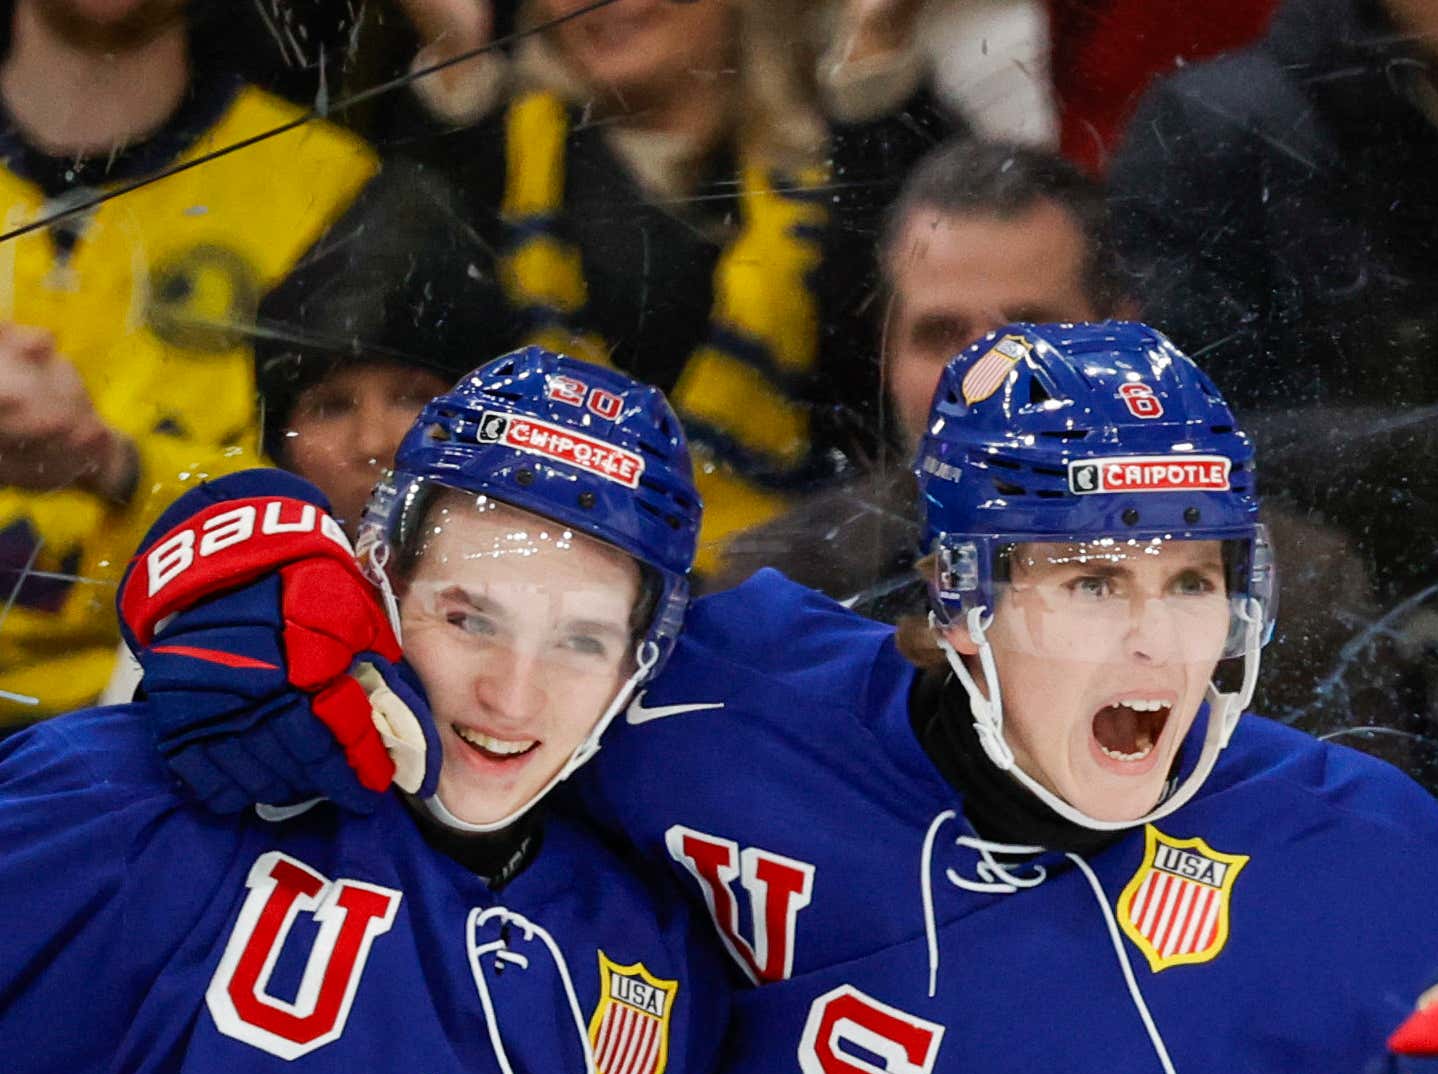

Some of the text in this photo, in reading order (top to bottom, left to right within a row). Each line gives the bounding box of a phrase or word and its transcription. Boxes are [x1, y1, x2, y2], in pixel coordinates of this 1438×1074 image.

[549, 376, 623, 421] 20
[1119, 382, 1163, 419] 6
[1163, 848, 1215, 883] USA
[617, 976, 658, 1013] USA
